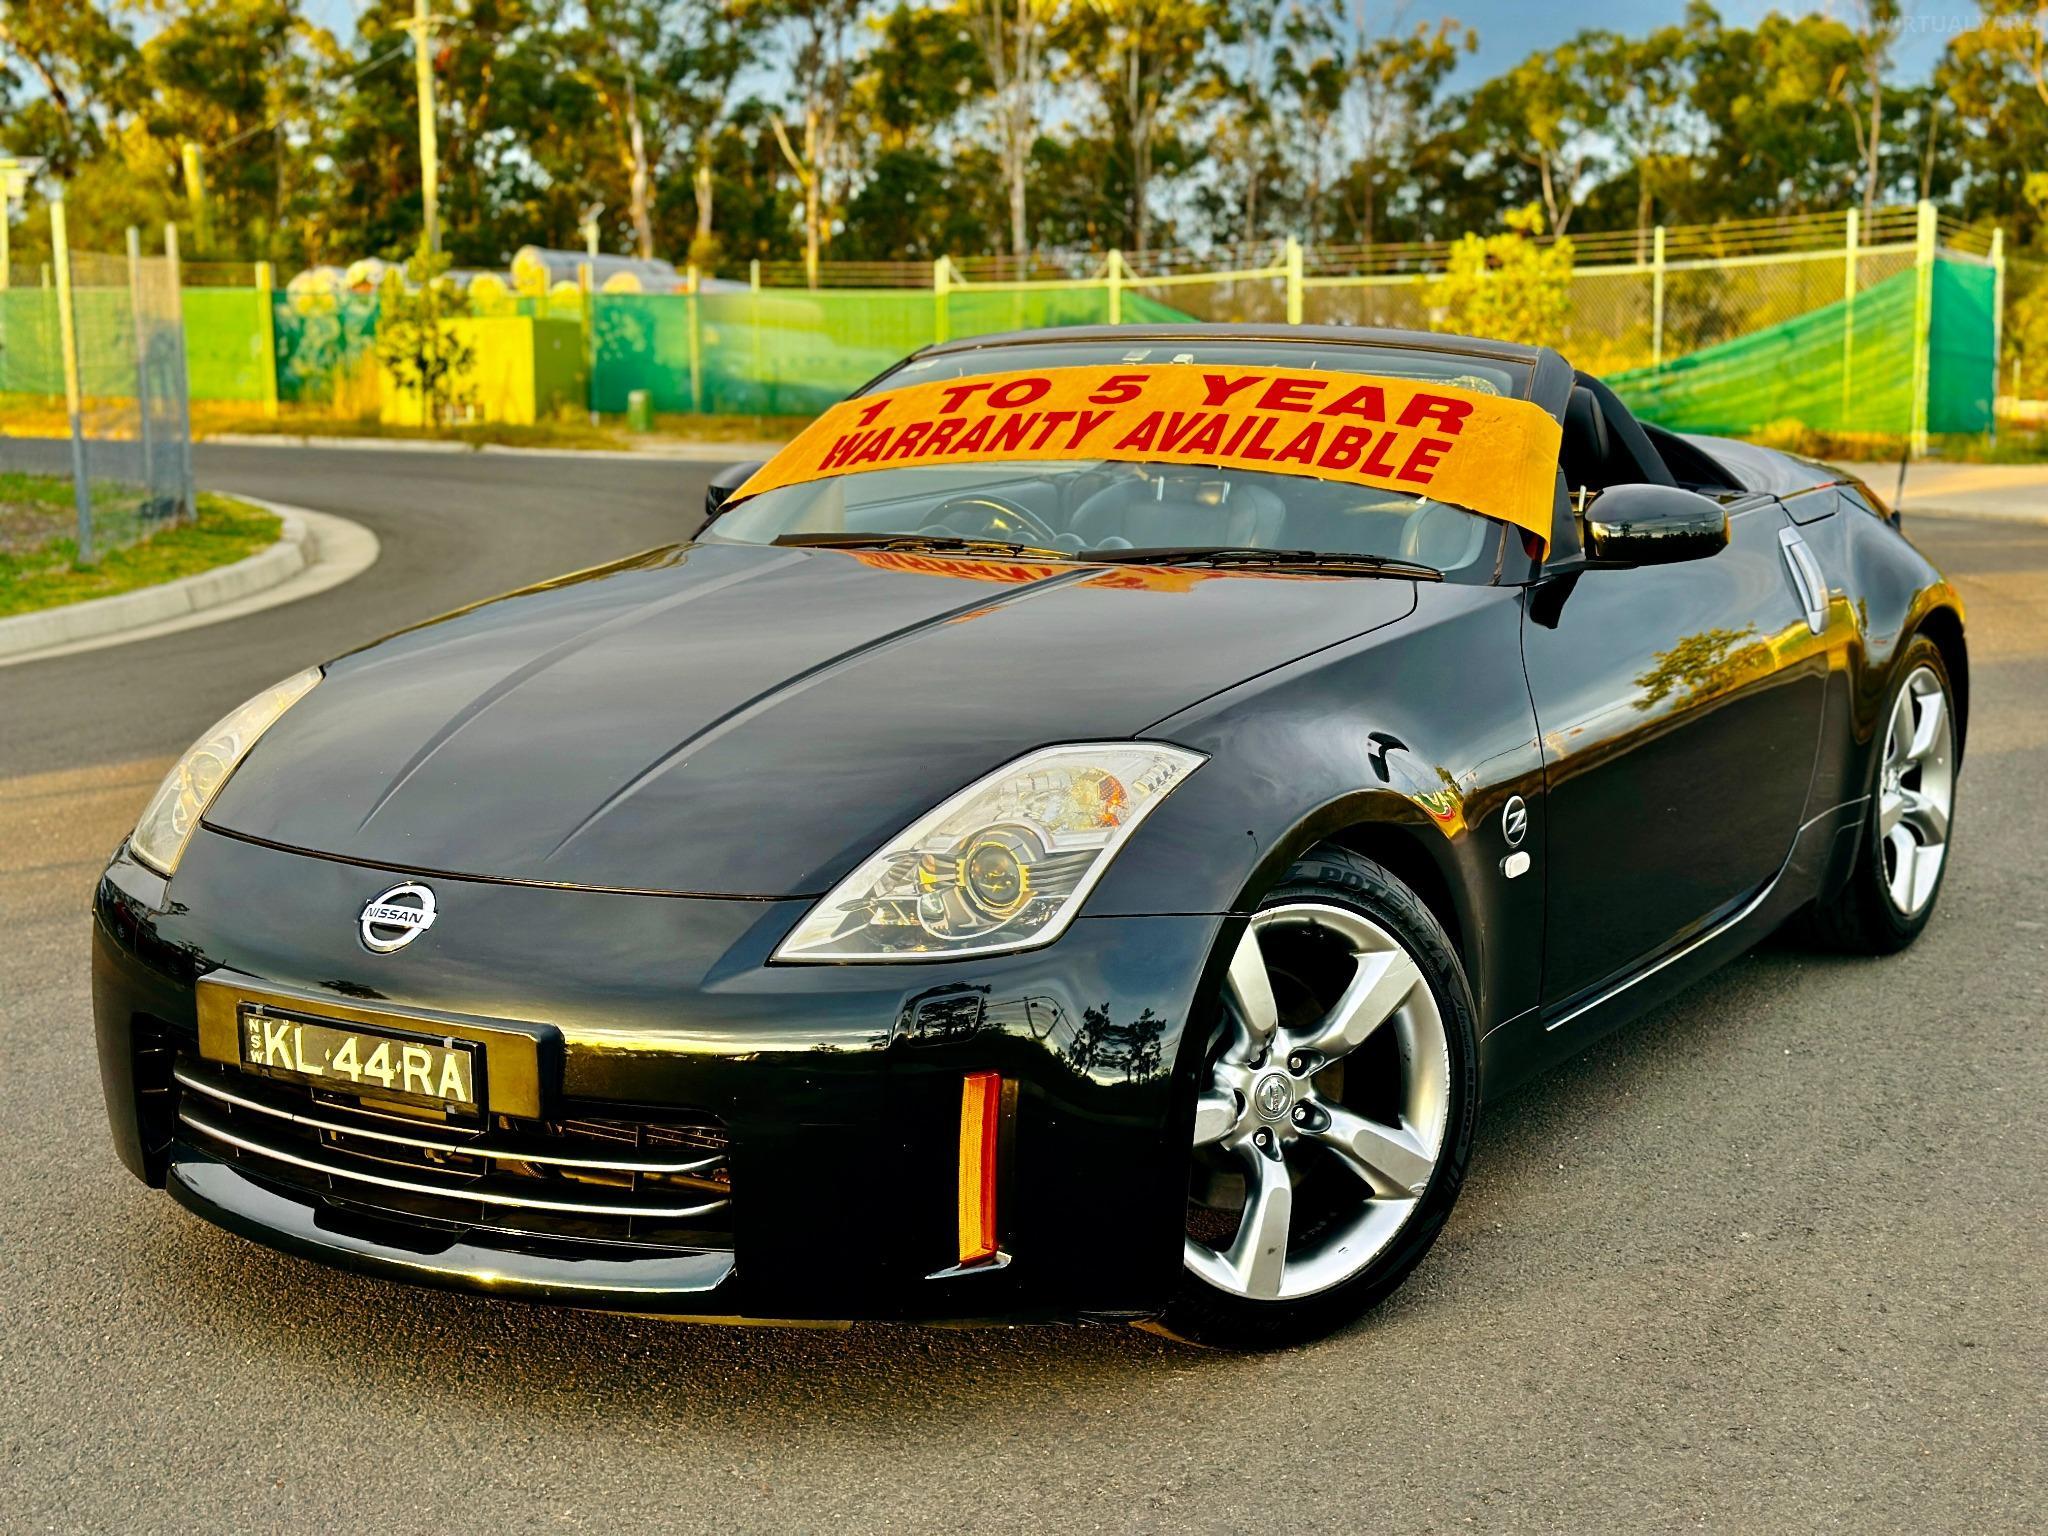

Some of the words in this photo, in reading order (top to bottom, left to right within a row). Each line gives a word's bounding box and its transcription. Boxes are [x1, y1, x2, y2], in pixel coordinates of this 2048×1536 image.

[858, 400, 891, 426] 1
[940, 378, 1051, 413] TO
[1089, 375, 1149, 404] 5
[1202, 375, 1473, 435] YEAR
[818, 411, 1115, 470] WARRANTY
[1114, 411, 1453, 484] AVAILABLE
[366, 907, 424, 924] NISSAN
